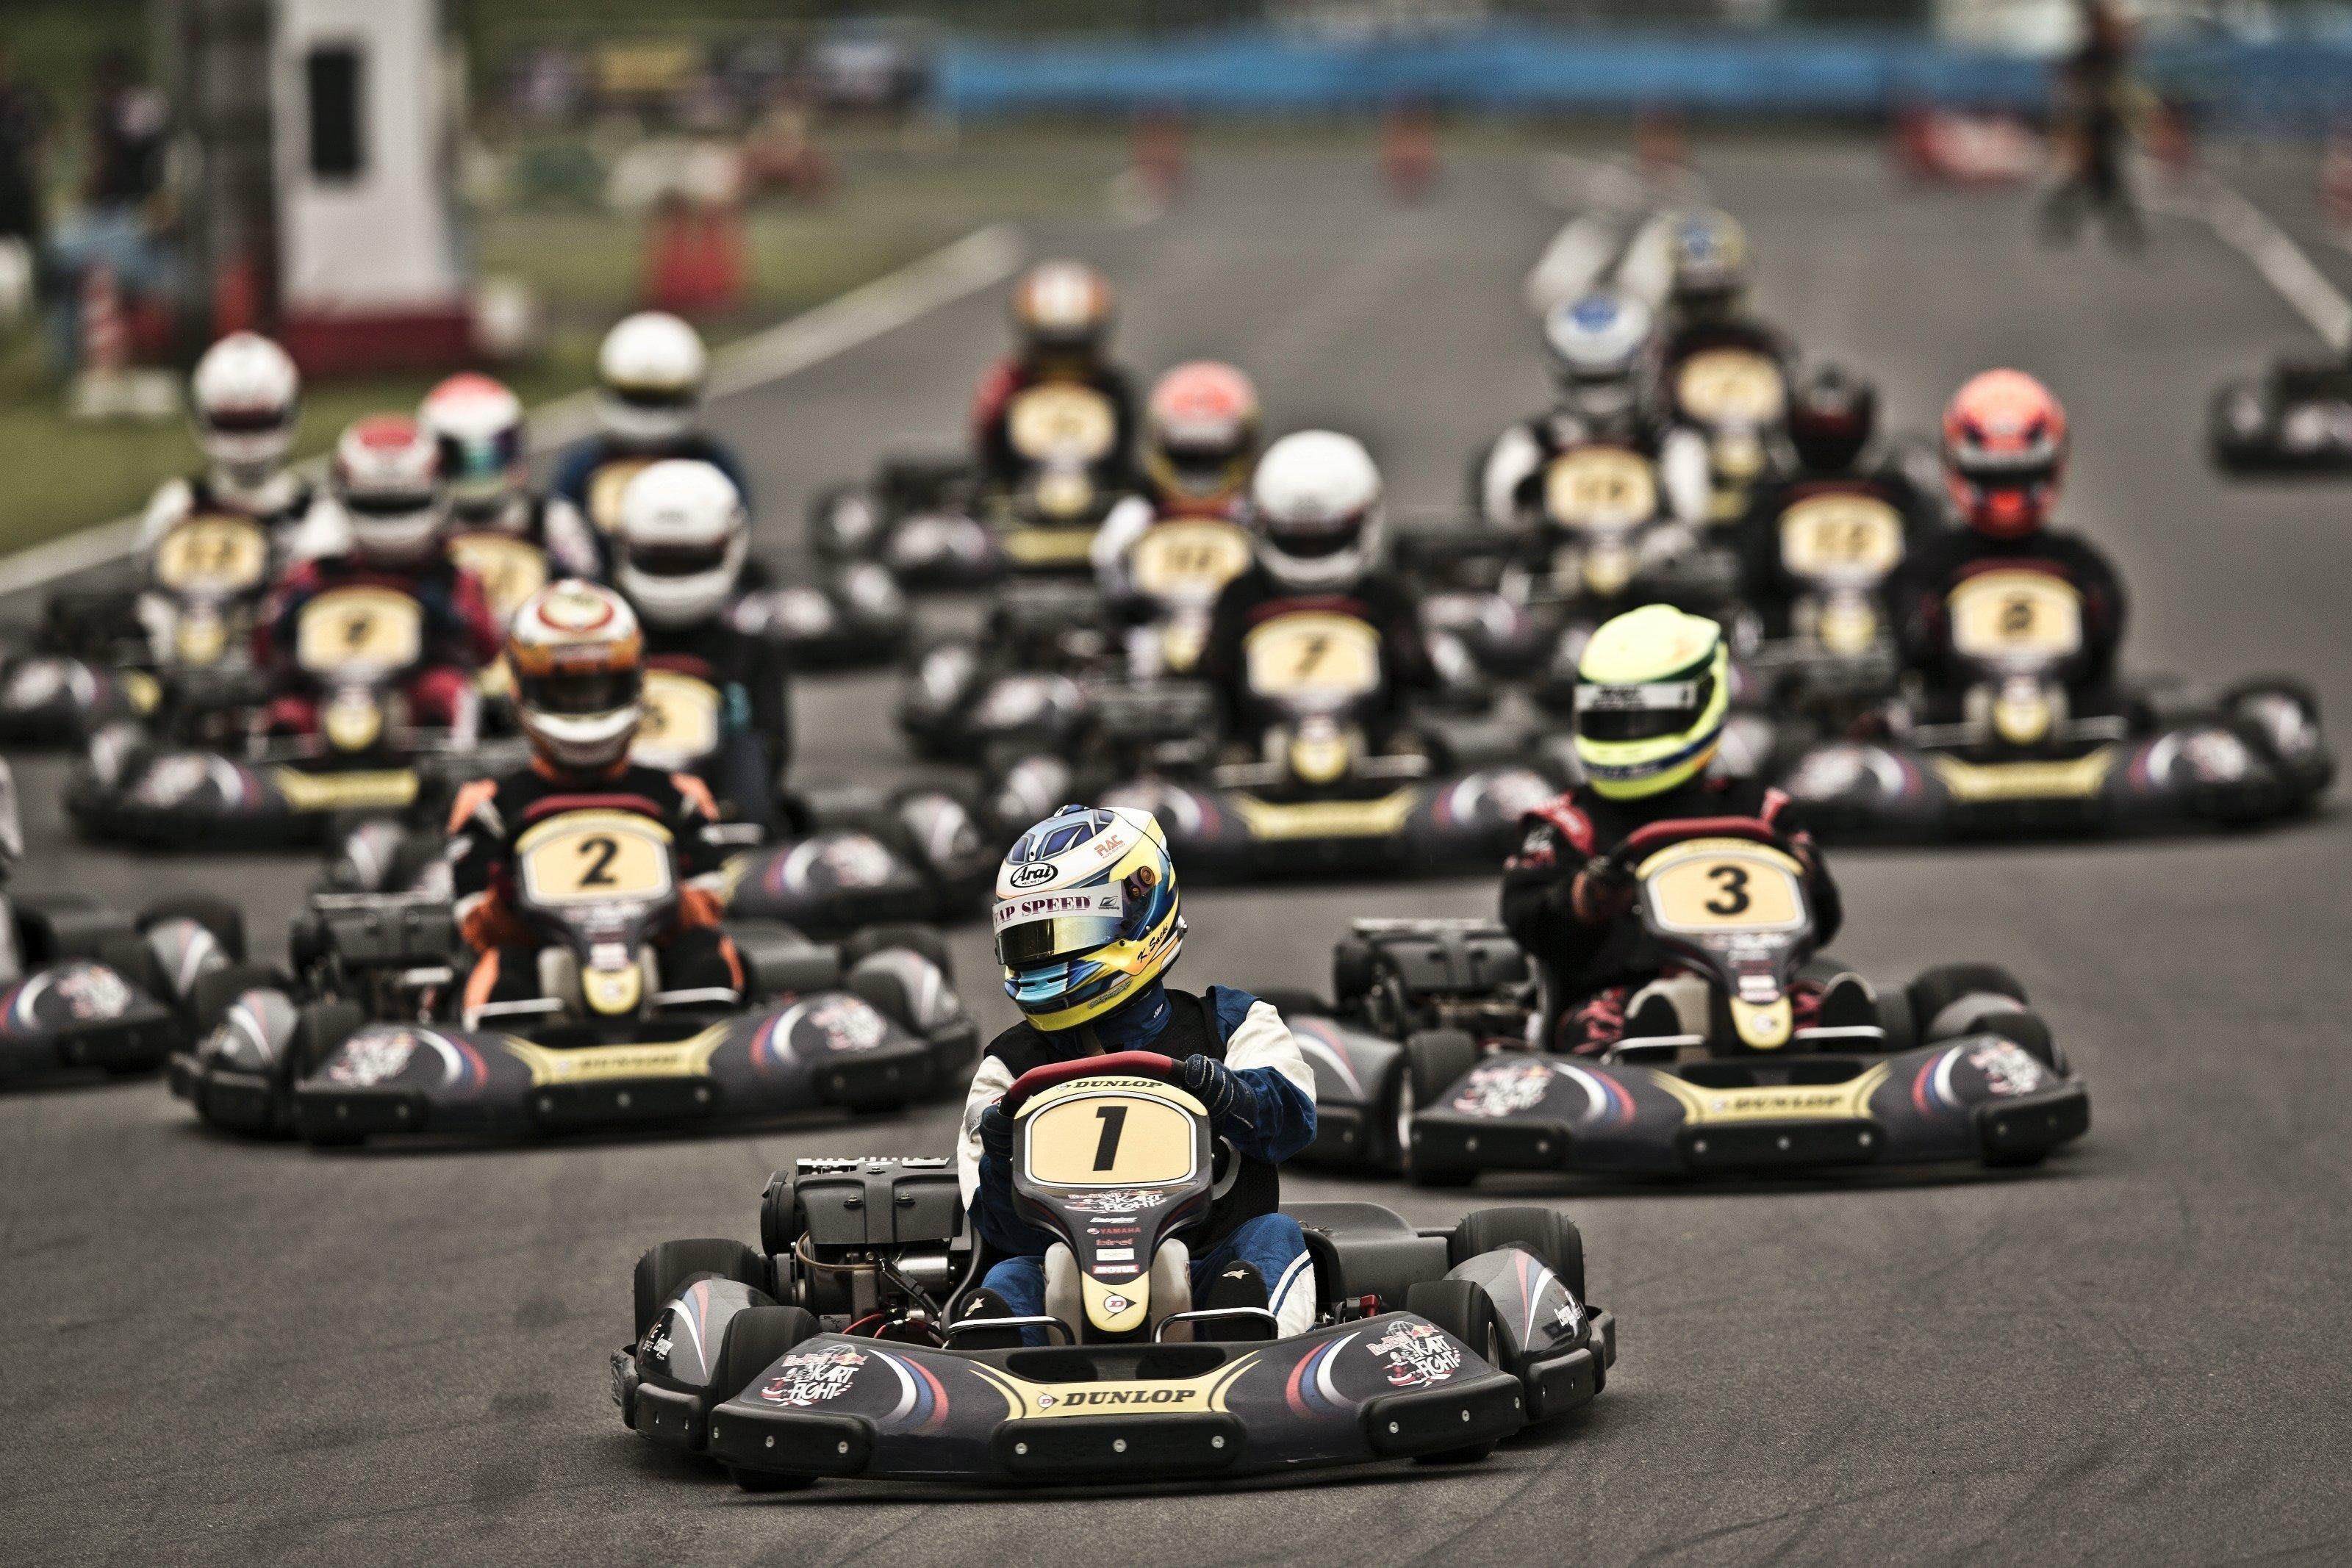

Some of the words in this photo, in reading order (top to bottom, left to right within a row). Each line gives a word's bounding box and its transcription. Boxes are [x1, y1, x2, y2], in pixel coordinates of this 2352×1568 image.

[1094, 835, 1123, 856] RAC
[577, 835, 619, 887] 2
[1014, 865, 1051, 882] Arai
[1705, 864, 1750, 916] 3
[1022, 896, 1091, 916] SPEED
[1073, 1080, 1163, 1088] DUNLOP
[1092, 1106, 1128, 1171] 1
[1094, 1265, 1138, 1274] MOTUL
[1408, 1334, 1452, 1357] KART
[808, 1364, 860, 1383] KART
[1415, 1351, 1460, 1379] FIGHT
[789, 1381, 842, 1400] FIGHT
[1062, 1389, 1196, 1406] DUNLOP
